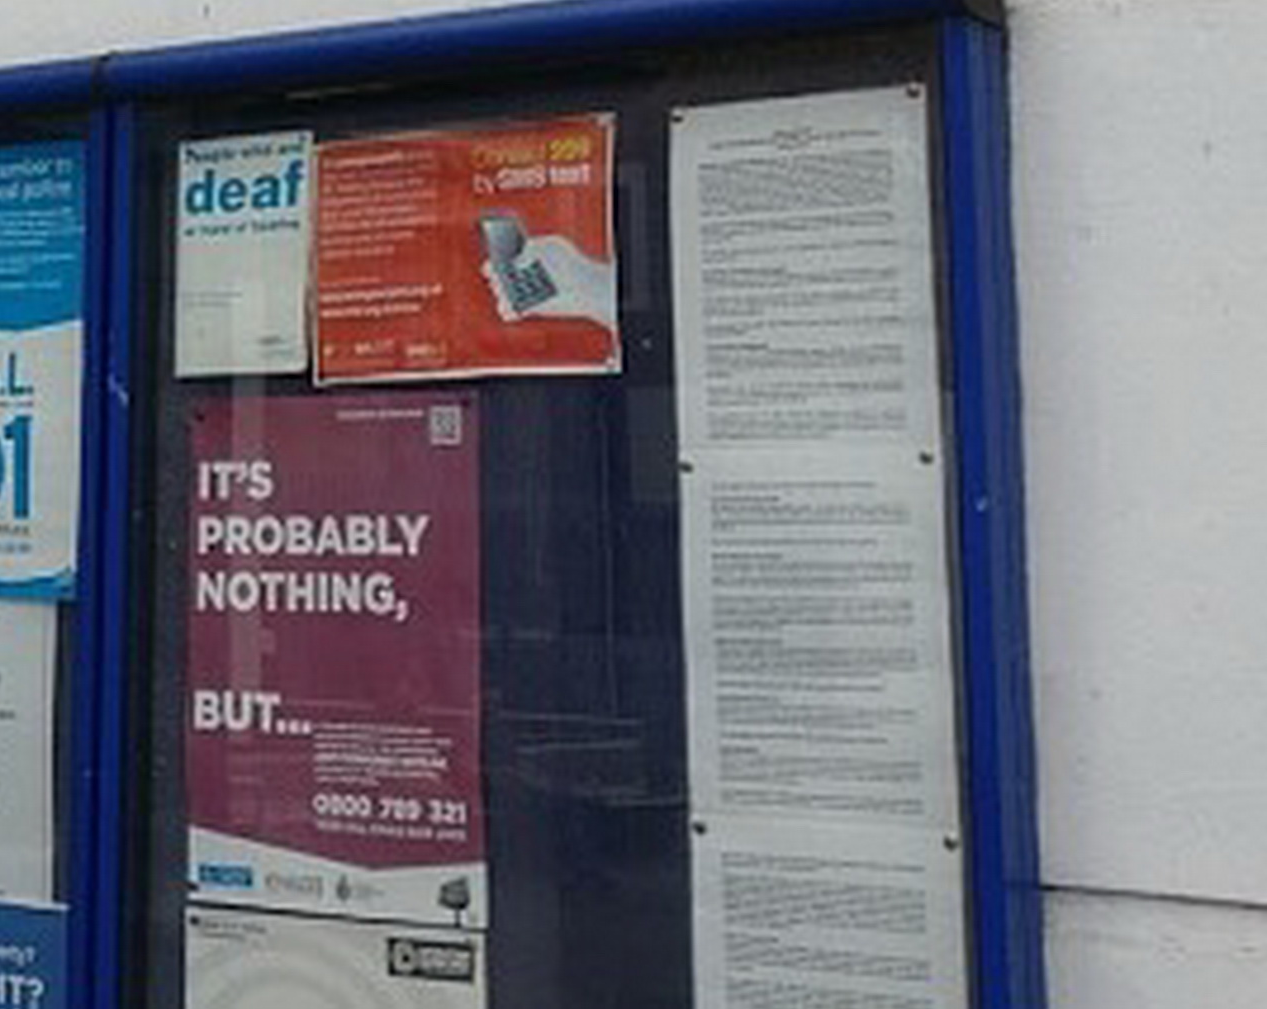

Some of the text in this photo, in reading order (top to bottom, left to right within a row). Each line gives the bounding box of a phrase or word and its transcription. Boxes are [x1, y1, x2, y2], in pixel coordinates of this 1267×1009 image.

[185, 158, 304, 214] deaf
[198, 460, 276, 501] IT'S
[197, 515, 431, 556] PROBABLY
[196, 571, 410, 623] NOTHING,
[192, 690, 313, 735] BUT...
